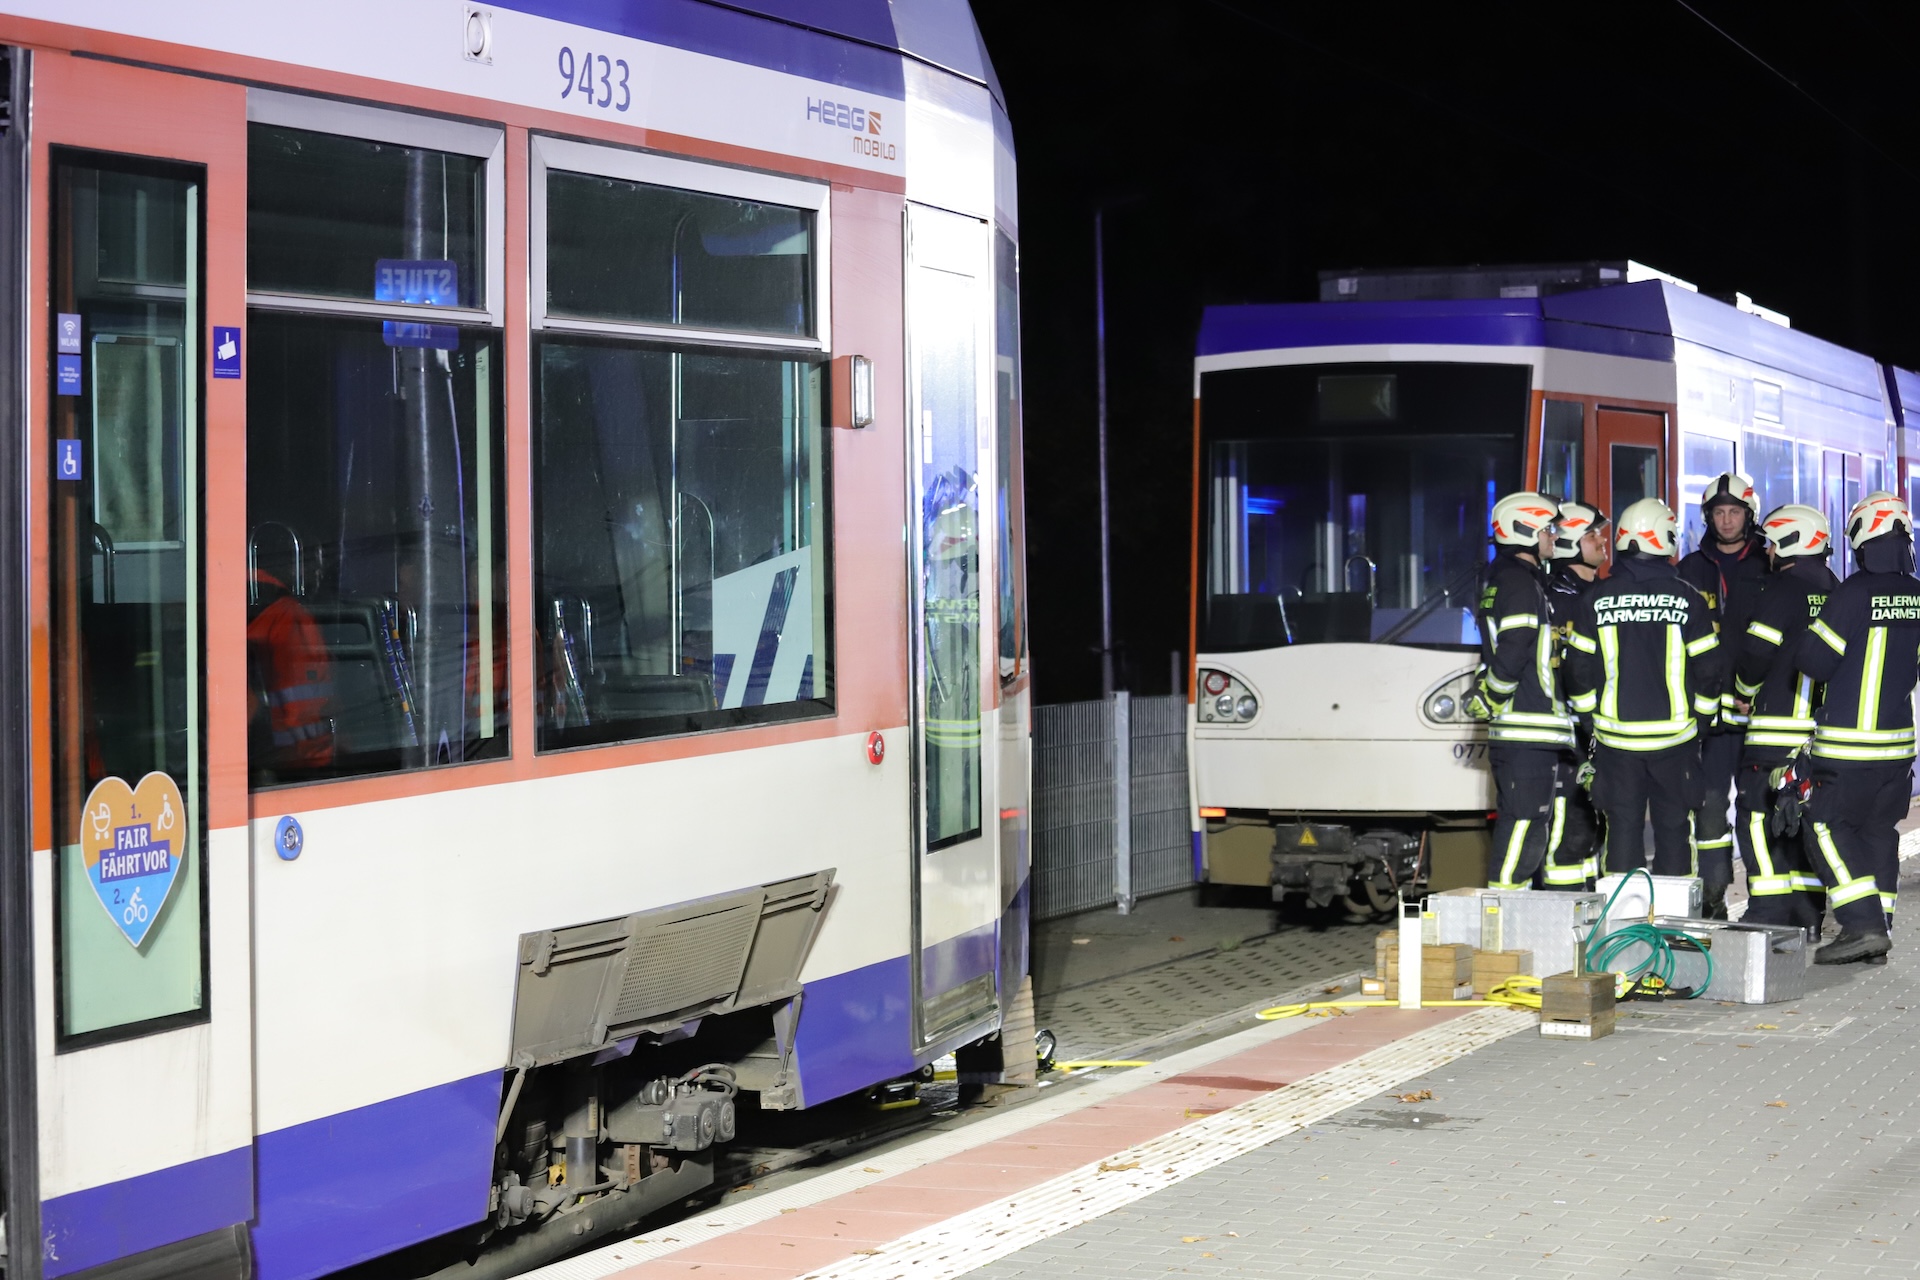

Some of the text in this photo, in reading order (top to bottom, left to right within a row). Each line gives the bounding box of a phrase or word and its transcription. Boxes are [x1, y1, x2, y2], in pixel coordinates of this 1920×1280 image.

[558, 46, 631, 112] 9433
[853, 136, 896, 160] MOBILO
[60, 337, 79, 347] WLAN
[1871, 595, 1920, 608] FEUERW
[131, 803, 142, 819] 1.
[117, 827, 149, 851] FAIR
[101, 849, 168, 879] FÄHRT VOR
[113, 888, 125, 904] 2.
